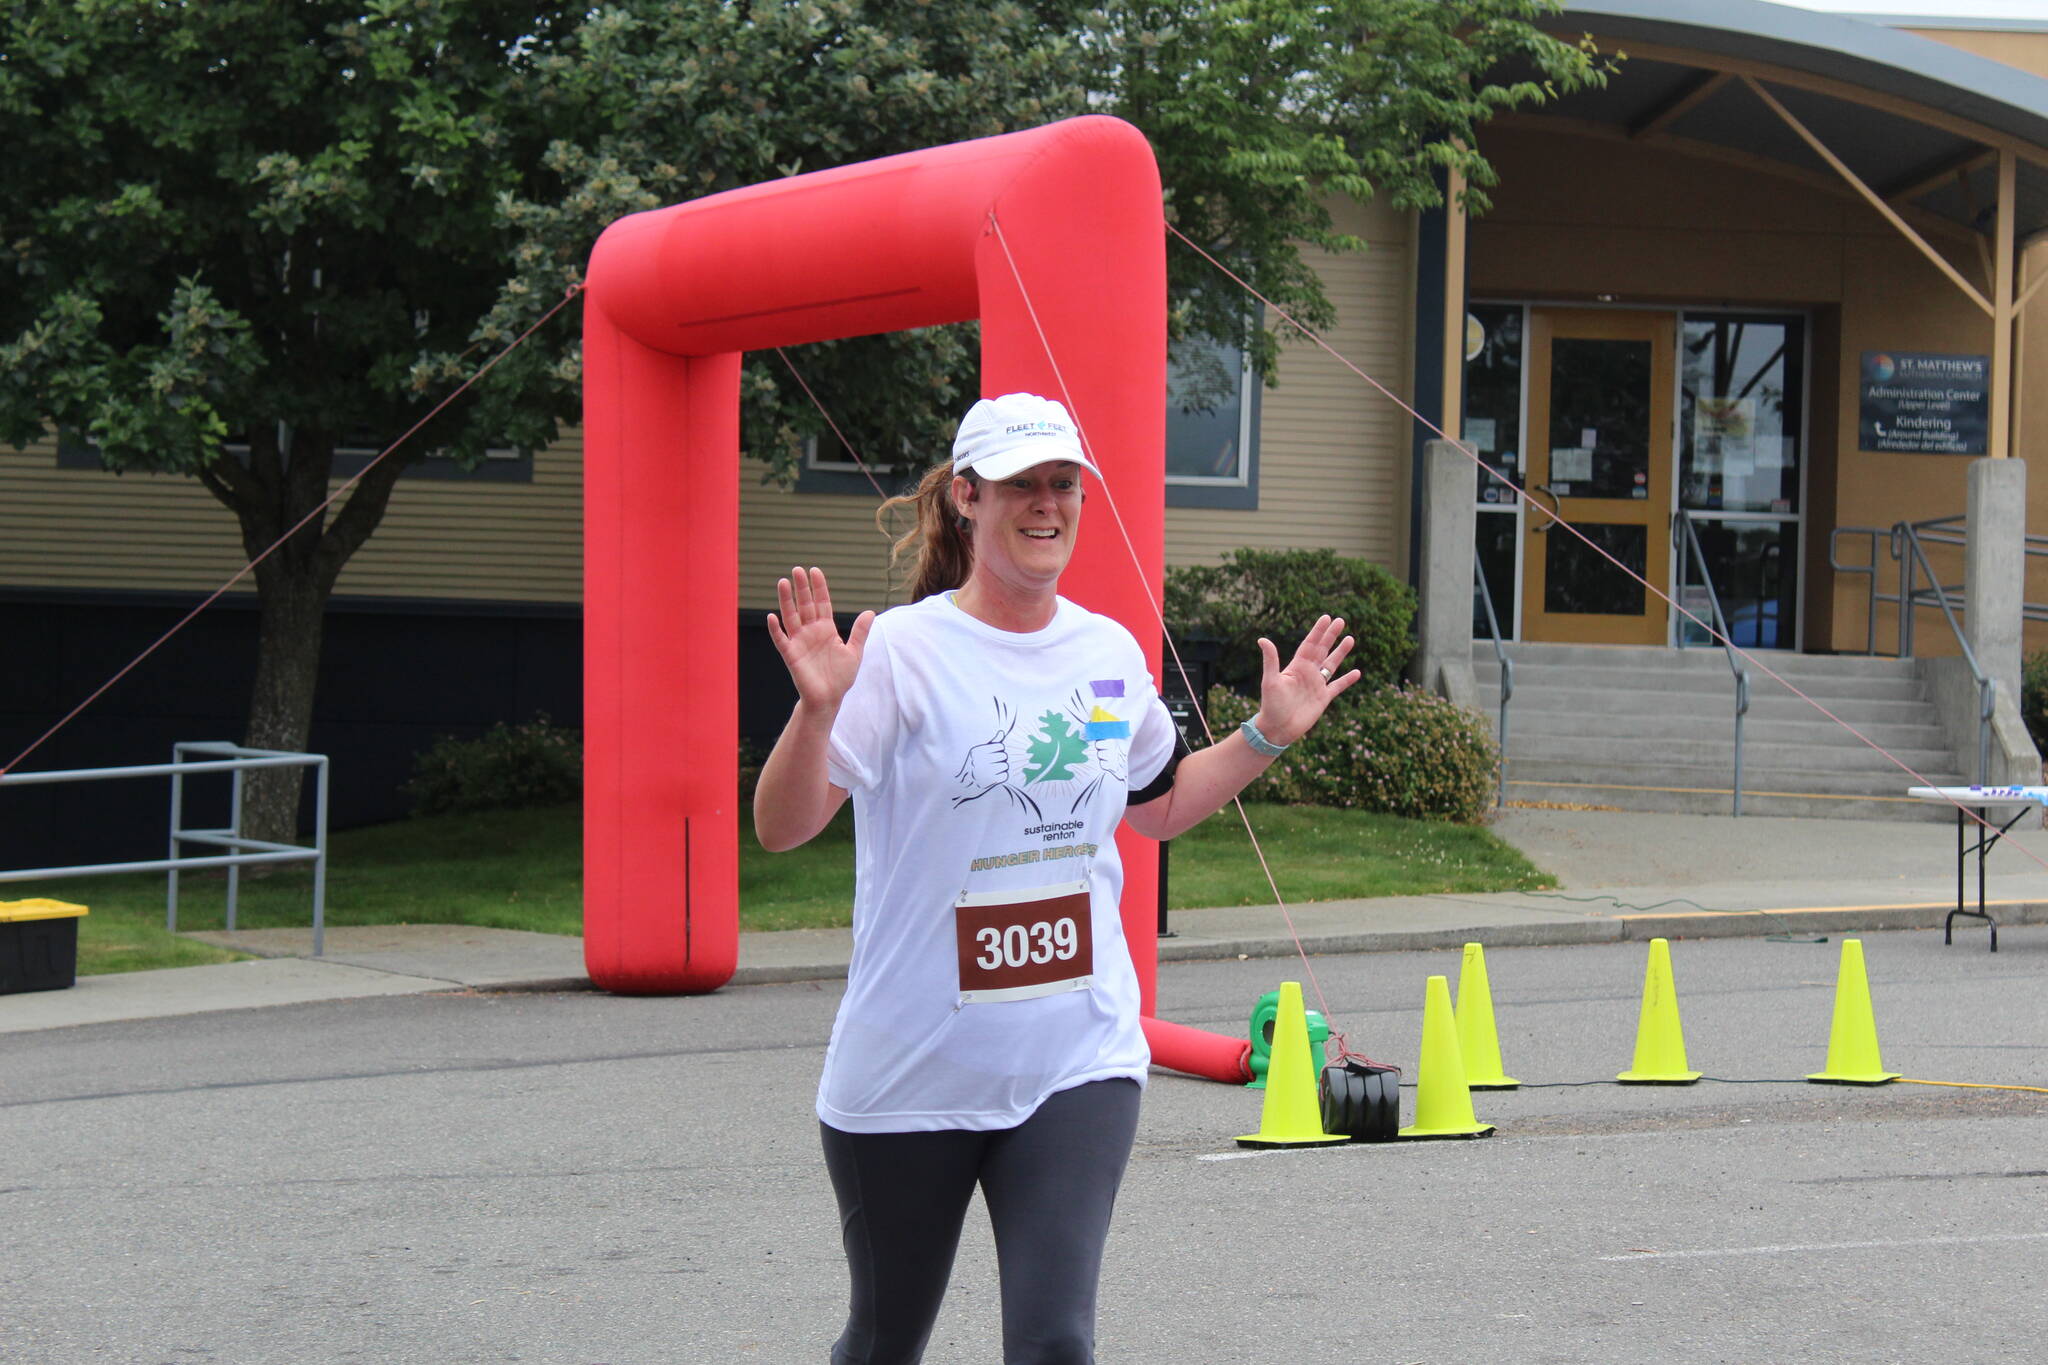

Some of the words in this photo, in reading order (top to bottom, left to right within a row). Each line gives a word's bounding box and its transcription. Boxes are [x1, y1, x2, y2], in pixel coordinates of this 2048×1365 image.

[1869, 387, 1944, 400] Administration
[1947, 390, 1980, 401] Center
[1006, 423, 1034, 433] FLEET
[1897, 416, 1951, 430] Kindering
[1024, 820, 1084, 835] sustainable
[1043, 830, 1075, 841] renton
[970, 850, 1040, 871] HUNGER
[976, 917, 1078, 970] 3039
